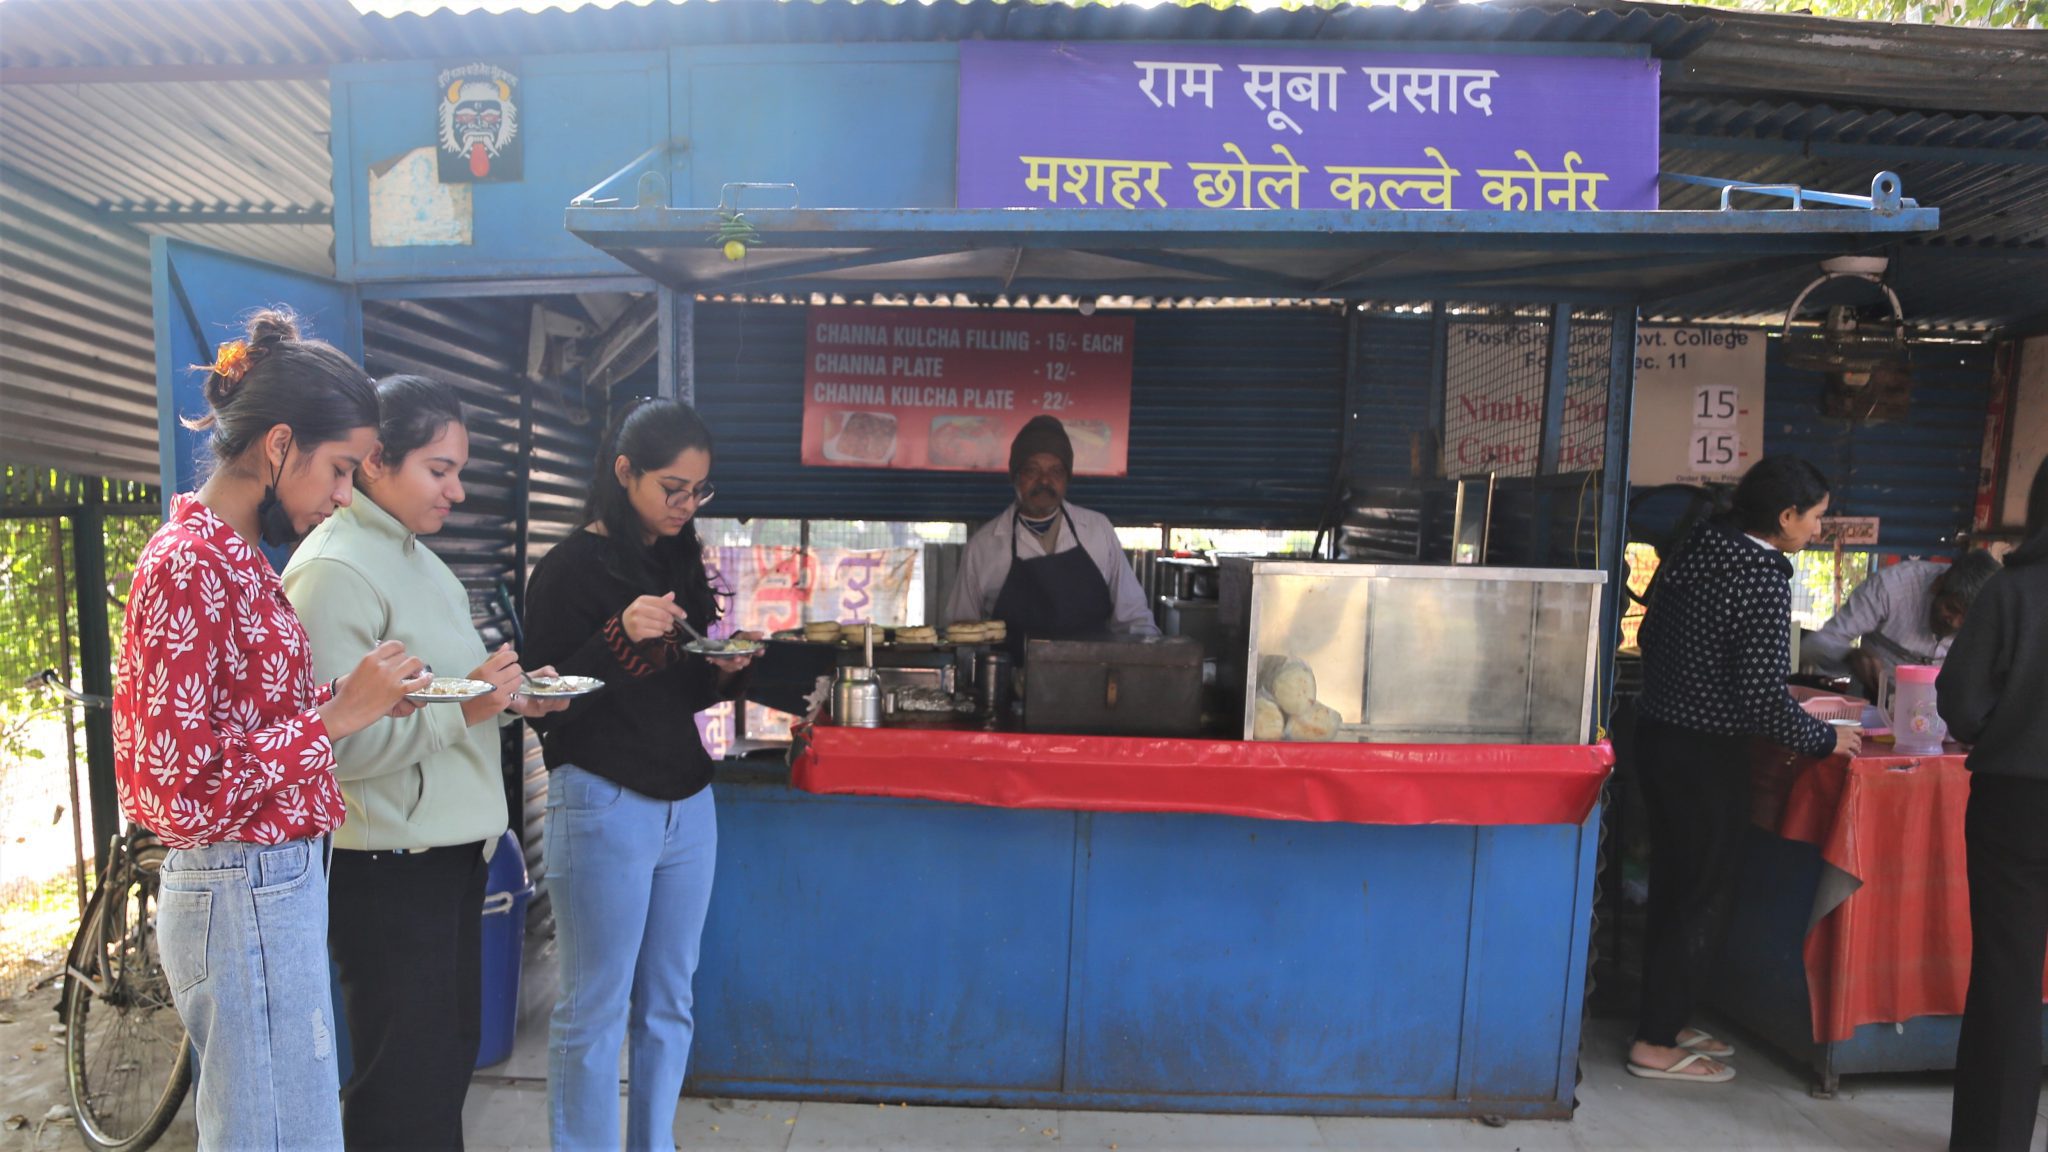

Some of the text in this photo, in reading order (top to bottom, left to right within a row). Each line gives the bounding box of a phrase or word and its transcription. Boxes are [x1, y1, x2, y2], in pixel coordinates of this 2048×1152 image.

[1133, 61, 1500, 135] राम सूबा प्रसाद
[1187, 142, 1309, 209] छोले
[1476, 149, 1609, 211] कोर्नर
[816, 323, 888, 346] CHANNA
[894, 326, 961, 347] KULCHA
[966, 329, 1030, 351] FILLING
[1082, 333, 1124, 353] EACH
[1674, 330, 1748, 349] College
[815, 353, 887, 375] CHANNA
[892, 356, 943, 377] PLATE
[1635, 356, 1660, 369] ec.
[1668, 353, 1686, 369] 11
[813, 382, 886, 405] CHANNA
[890, 385, 958, 408] KULCHA
[963, 388, 1014, 410] PLATE
